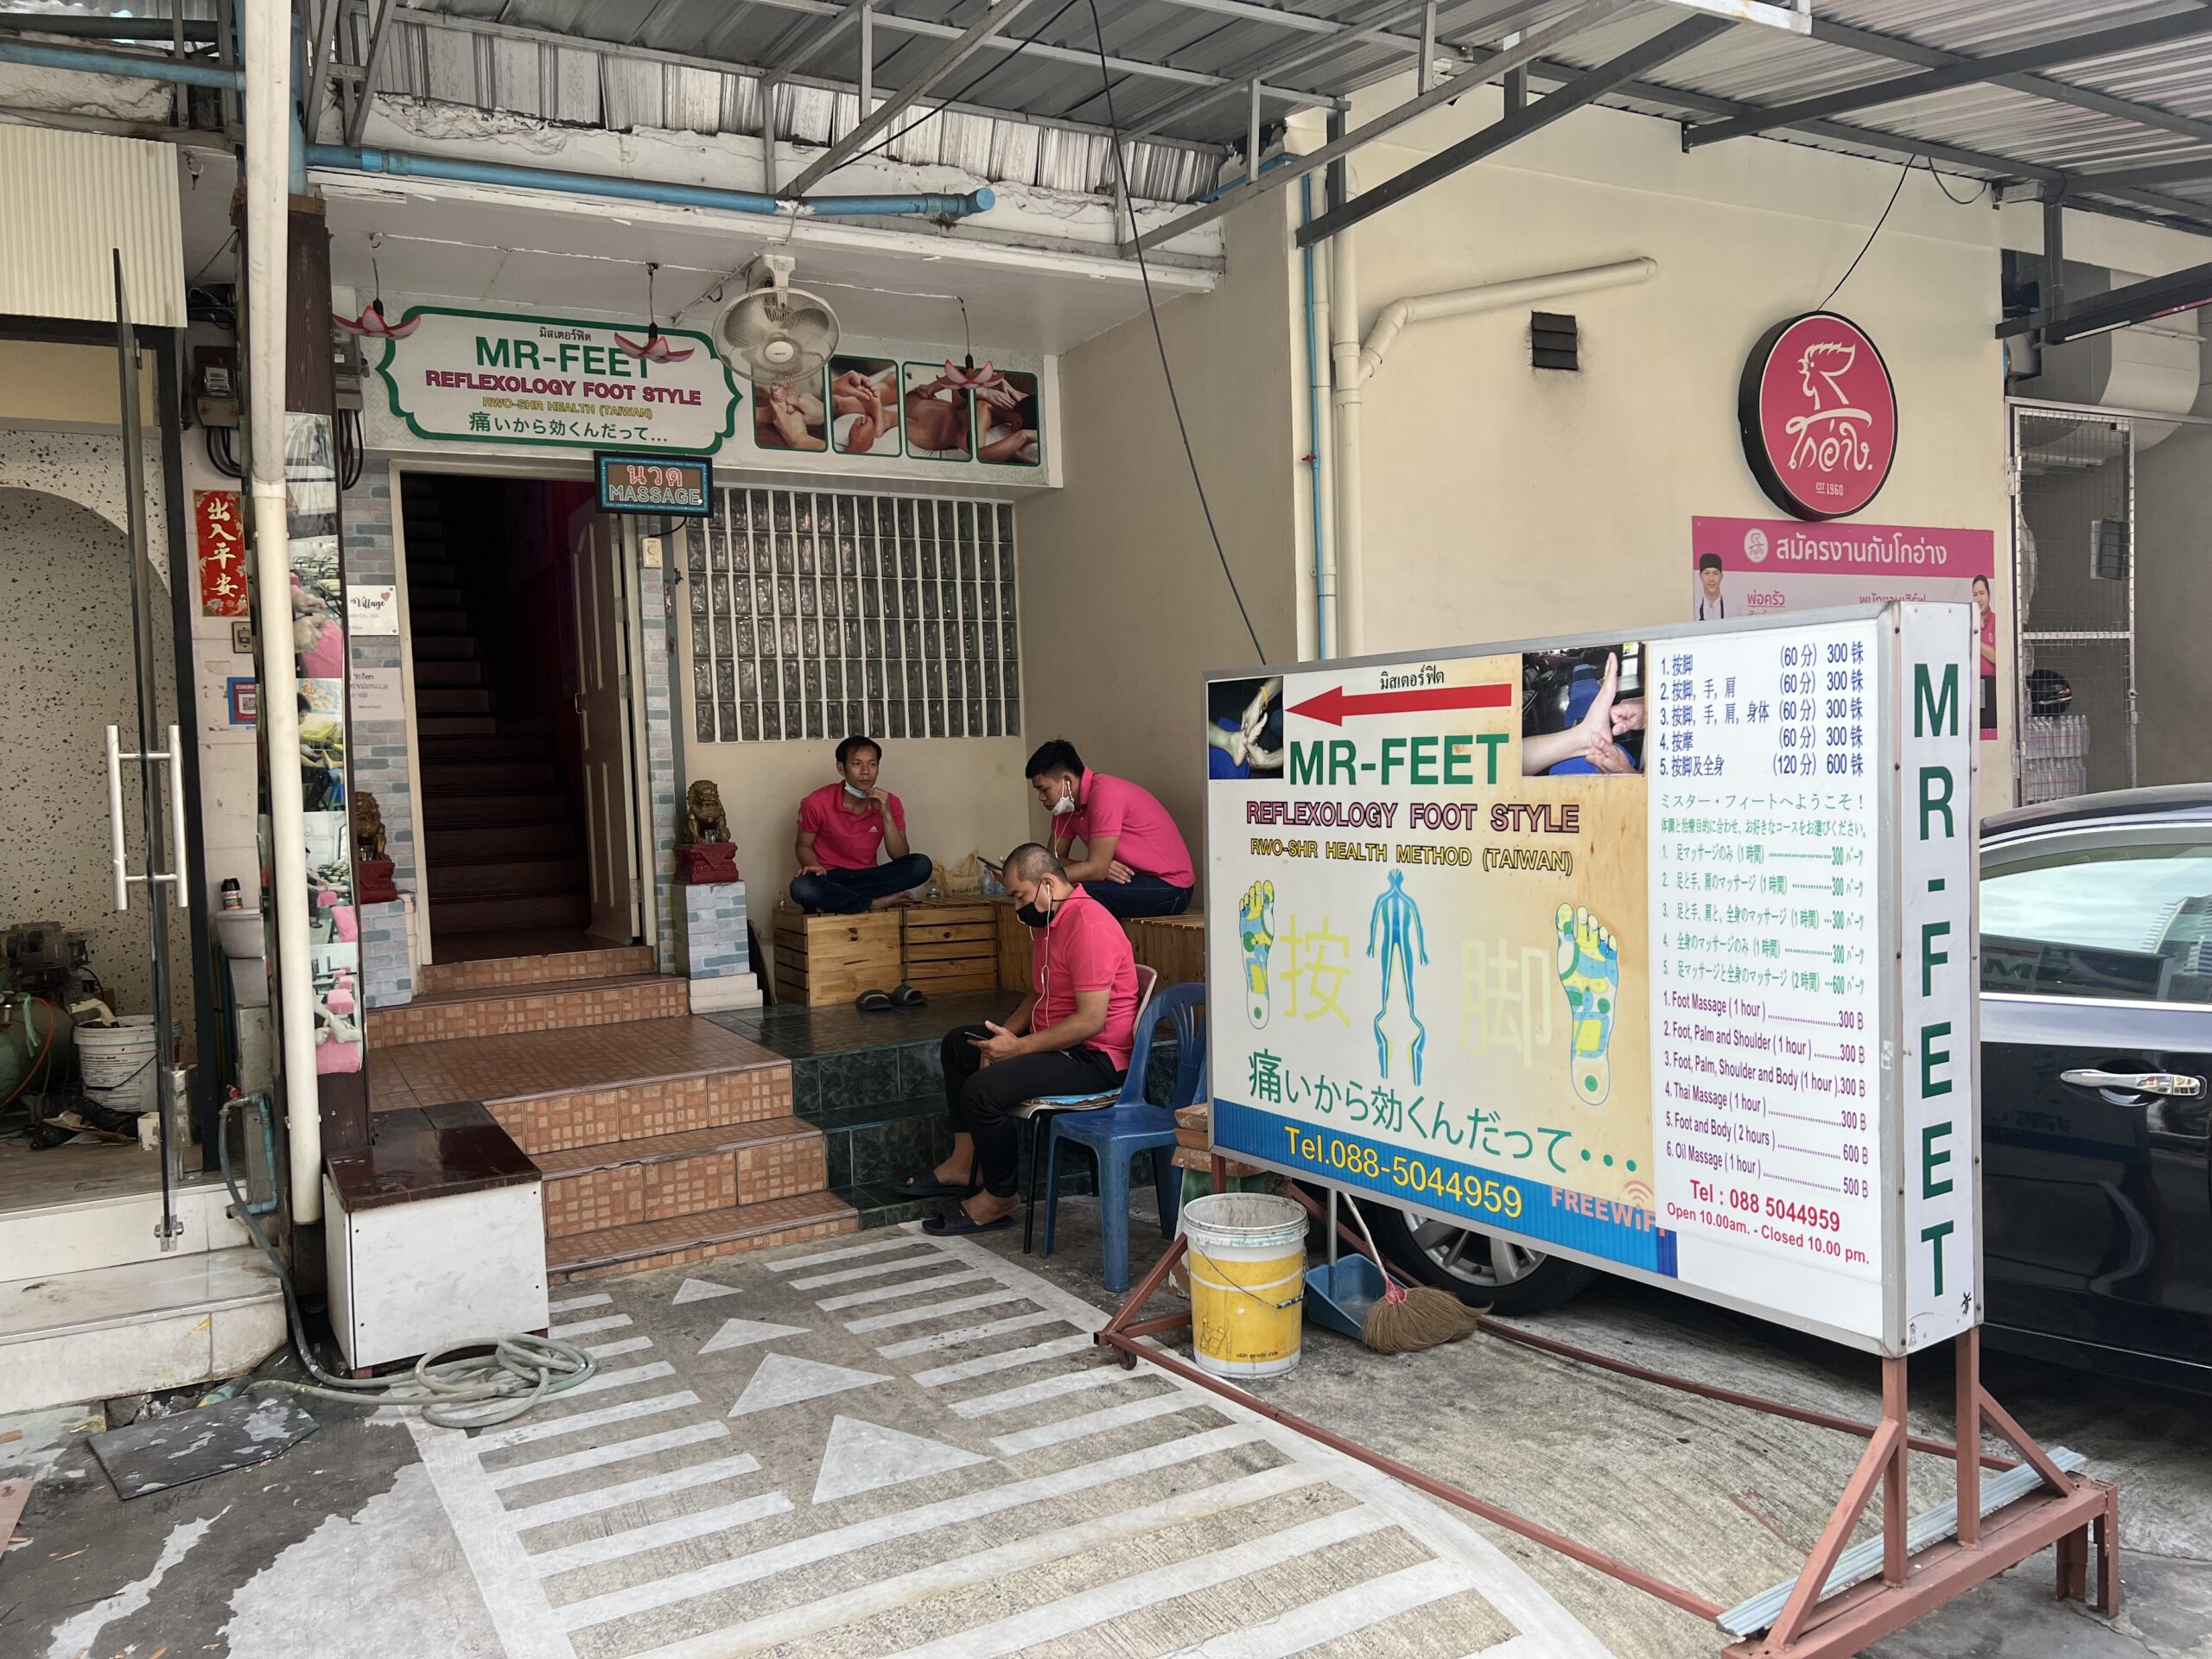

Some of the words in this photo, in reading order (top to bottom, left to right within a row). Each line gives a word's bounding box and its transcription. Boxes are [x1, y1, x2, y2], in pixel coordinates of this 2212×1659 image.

[425, 370, 575, 397] REFLEXOLOGY
[583, 382, 639, 401] FOOT
[642, 387, 702, 405] STYLE
[482, 397, 543, 410] RWO-SHR
[547, 401, 595, 415] HEALTH
[600, 404, 652, 420] (TAIWAN)
[627, 464, 683, 486] นวด
[1827, 483, 1843, 496] 1960
[609, 484, 702, 505] MASSAGE
[207, 498, 238, 598] 出入平安
[1777, 531, 1948, 566] สมัครงานกับโกอ่าง
[1747, 590, 1785, 606] พ่อครัว
[1827, 644, 1847, 664] 300
[1380, 664, 1445, 690] มิสเตอร์ฟิต
[1827, 671, 1847, 692] 300
[1826, 699, 1847, 719] 300
[1672, 730, 1694, 751] 按摩
[1826, 726, 1847, 747] 300
[1289, 733, 1510, 785] MR-FEET
[1827, 753, 1847, 775] 600
[1246, 801, 1398, 830] REFLEXOLOGY
[1410, 803, 1478, 830] FOOT
[1491, 804, 1580, 833] STYLE
[1251, 838, 1319, 859] RWO-SHR
[1325, 841, 1388, 861] HEALTH
[1396, 844, 1472, 867] METHOD
[1483, 848, 1573, 876] (TAIWAN)
[1672, 992, 1690, 1008] Foot
[1692, 994, 1726, 1017] Massage
[1839, 1010, 1854, 1029] 300
[1673, 1022, 1693, 1041] Foot,
[1694, 1025, 1714, 1043] Palm
[1717, 1030, 1731, 1046] and
[1733, 1030, 1770, 1051] Shoulder
[1840, 1044, 1855, 1063] 300
[1674, 1052, 1694, 1072] Foot,
[1695, 1055, 1717, 1077] Palm,
[1719, 1060, 1756, 1080] Shoulder
[1758, 1066, 1773, 1084] and
[1777, 1068, 1798, 1091] Body
[1840, 1077, 1856, 1096] 300
[1674, 1082, 1690, 1100] Thai
[1693, 1085, 1727, 1109] Massage
[1841, 1110, 1857, 1130] 300
[1675, 1113, 1693, 1130] Foot
[1694, 1118, 1708, 1134] and
[1711, 1119, 1732, 1141] Body
[1843, 1144, 1859, 1163] 600
[1284, 1125, 1522, 1218] Tel.088-5044959
[1675, 1143, 1687, 1160] Oil
[1688, 1145, 1723, 1171] Massage
[1843, 1177, 1859, 1196] 500
[1552, 1185, 1665, 1237] FREEWiF
[1690, 1179, 1713, 1203] Tel
[1730, 1189, 1759, 1213] 088
[1765, 1198, 1840, 1232] 5044959
[1667, 1202, 1696, 1222] Open
[1761, 1225, 1803, 1248] Closed
[1808, 1236, 1840, 1257] 10.00
[1845, 1247, 1869, 1264] pm.
